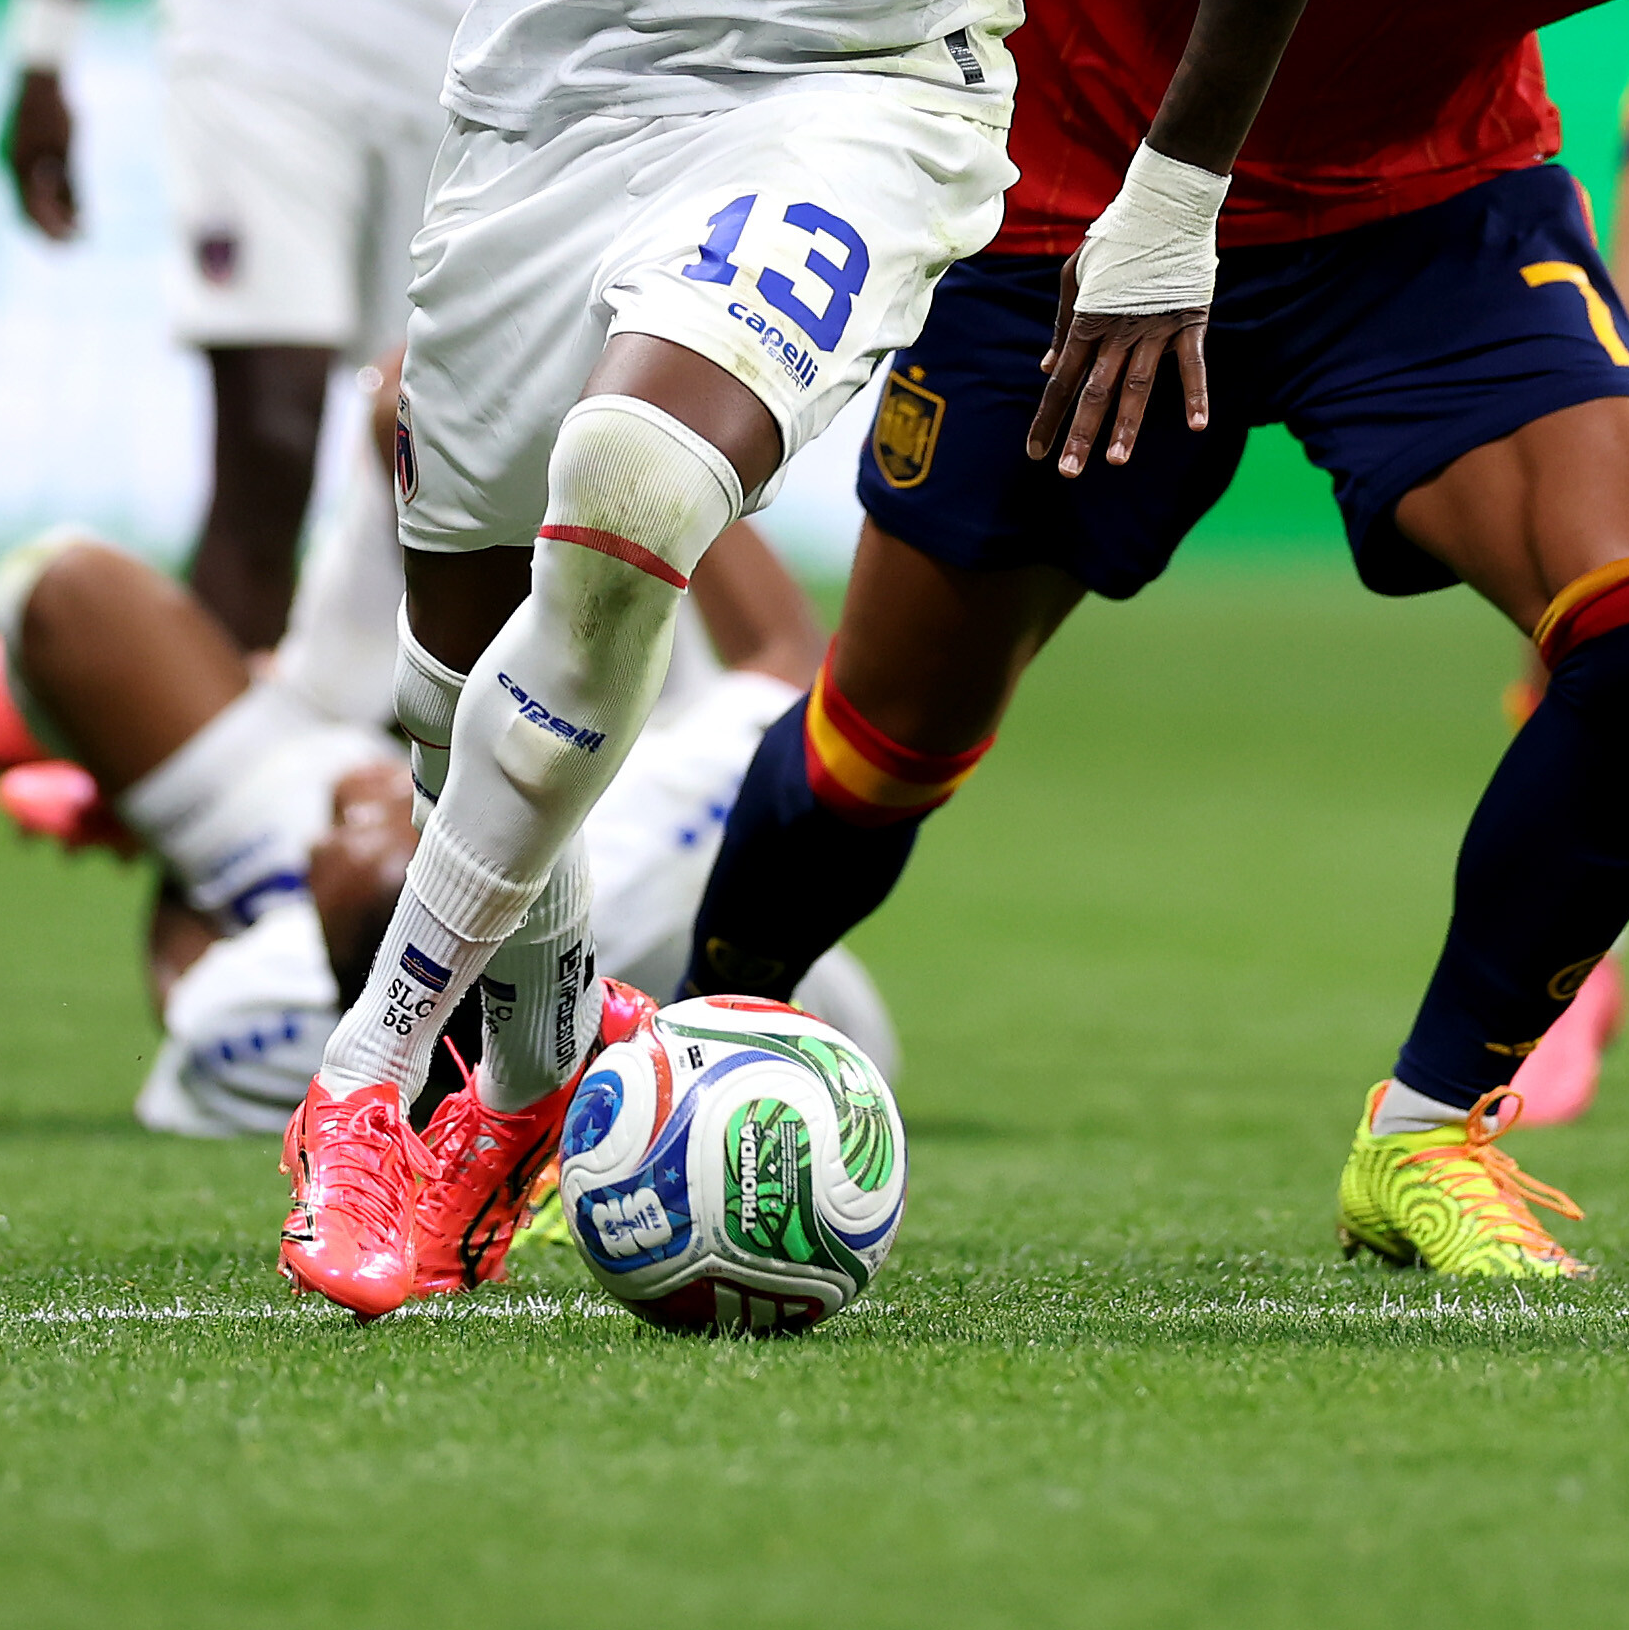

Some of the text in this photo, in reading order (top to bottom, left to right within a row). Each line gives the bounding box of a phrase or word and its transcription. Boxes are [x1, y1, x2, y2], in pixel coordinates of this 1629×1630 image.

[680, 193, 870, 352] 13
[728, 302, 818, 387] capelli
[497, 672, 606, 749] capelli
[383, 1005, 413, 1035] 55
[387, 978, 436, 1018] SLC
[740, 1122, 758, 1234] TRIONDA
